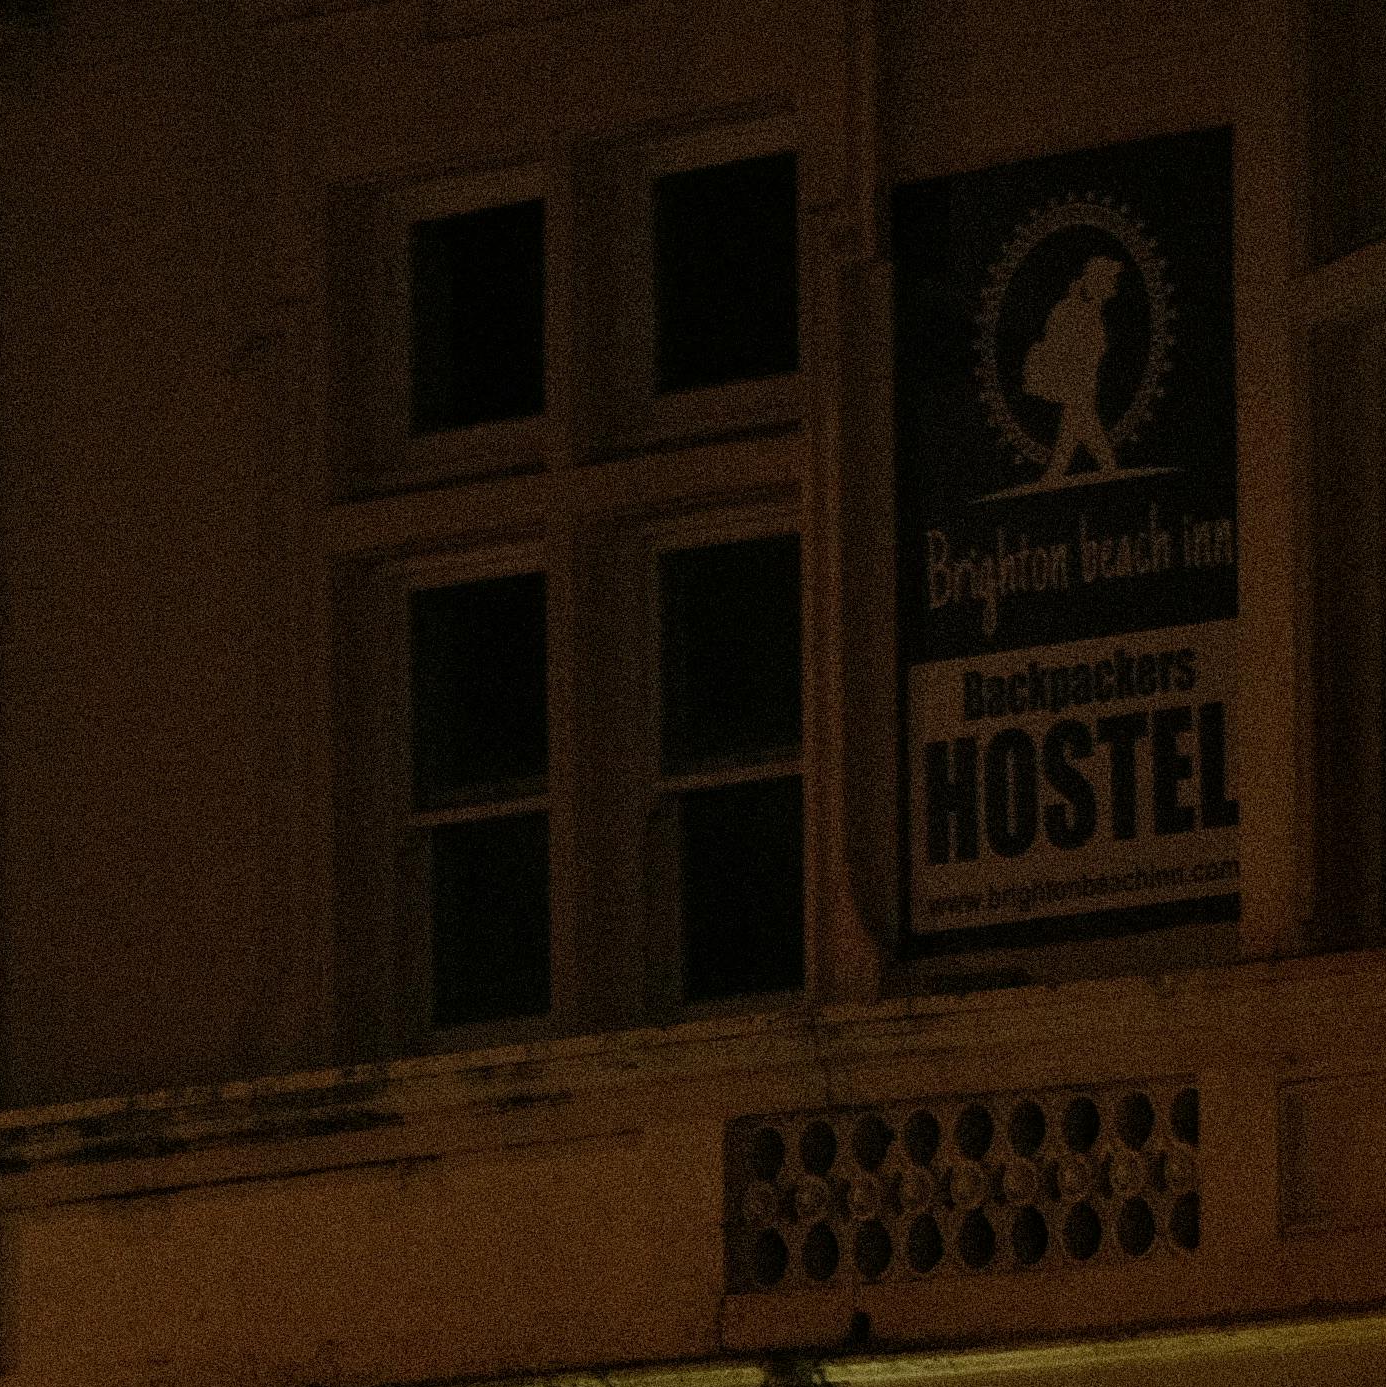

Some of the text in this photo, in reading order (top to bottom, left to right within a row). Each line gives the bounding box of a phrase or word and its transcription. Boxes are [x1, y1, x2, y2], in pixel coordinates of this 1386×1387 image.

[926, 502, 1238, 640] Brighton beach inn
[963, 648, 1196, 720] Backpackers
[925, 703, 1241, 865] HOSTEL
